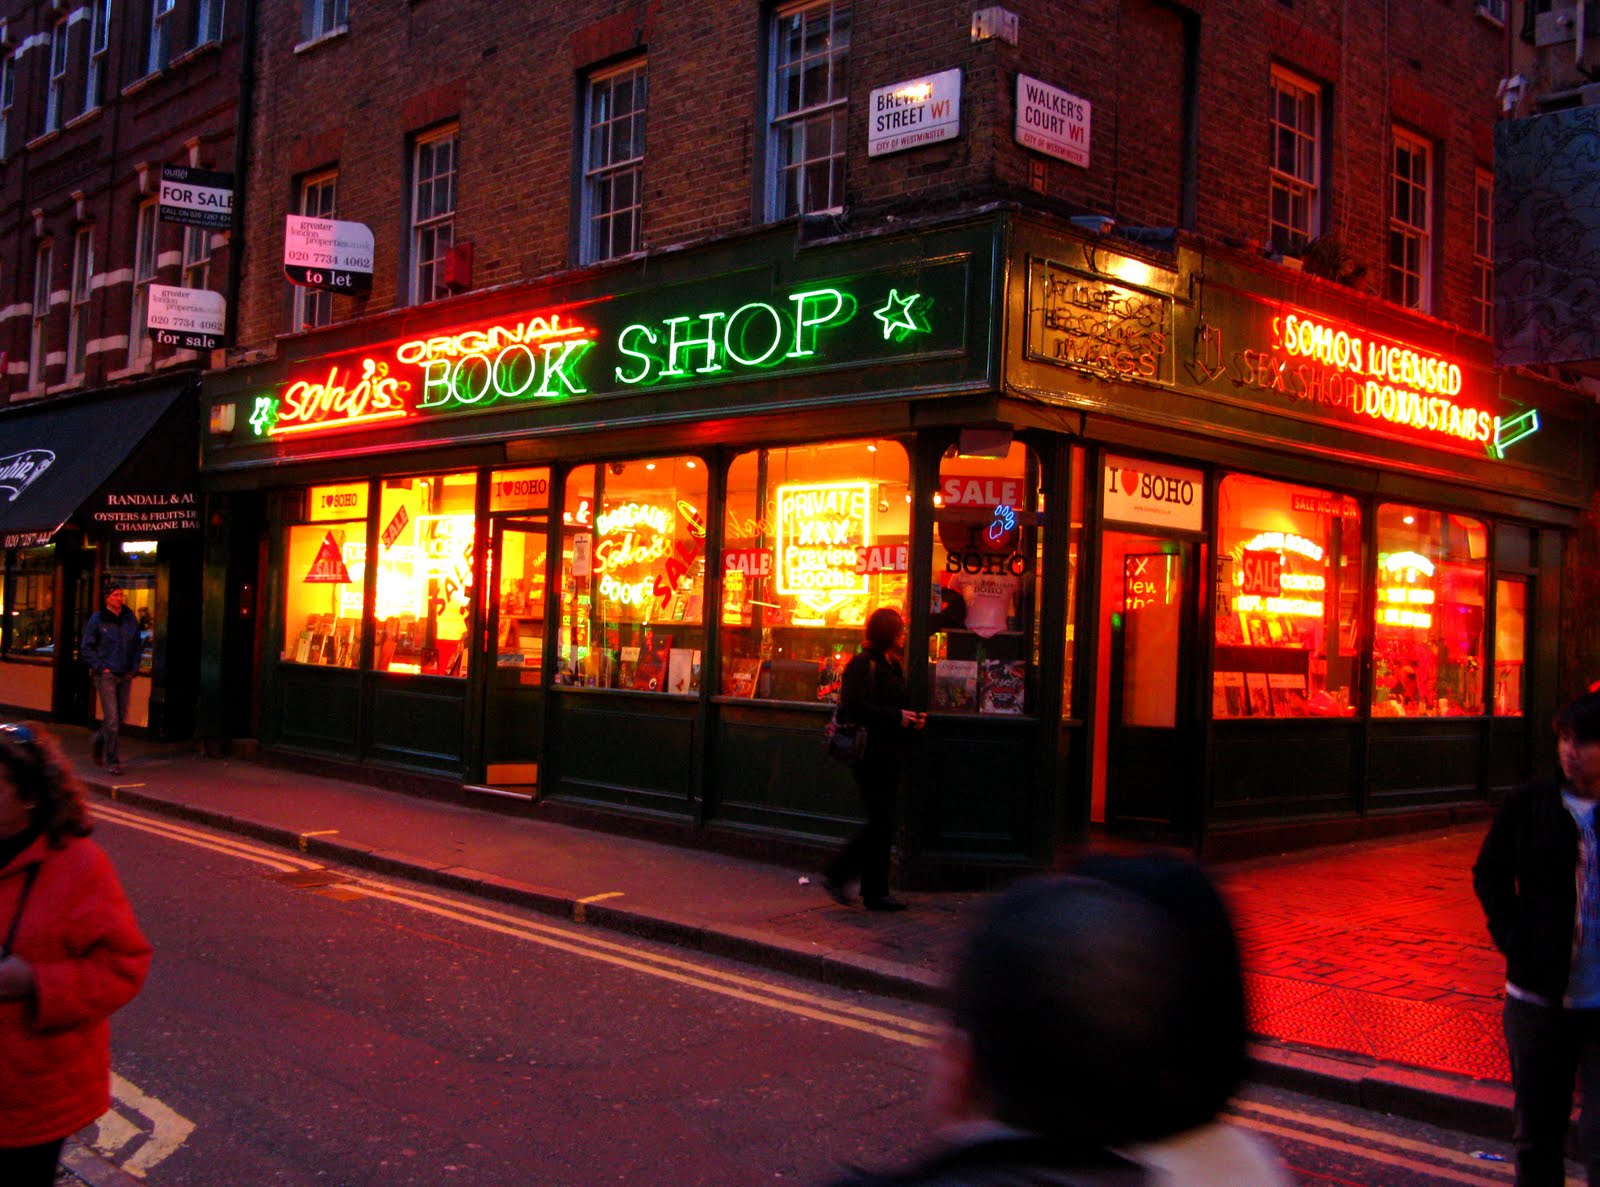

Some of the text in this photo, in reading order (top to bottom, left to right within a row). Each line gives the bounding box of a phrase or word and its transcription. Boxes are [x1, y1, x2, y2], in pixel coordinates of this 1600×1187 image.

[1026, 84, 1084, 122] WALKER'S
[876, 100, 950, 132] STREET W1
[1025, 105, 1085, 144] COURT W1
[876, 128, 945, 152] CITY OF WESTMINSTER
[1024, 132, 1084, 162] CITY OF WESTMINSTER
[163, 187, 233, 208] FOR SALE
[161, 207, 178, 216] CALL
[179, 209, 189, 217] ON
[190, 210, 202, 218] 020
[291, 227, 319, 238] london
[300, 221, 333, 231] greater
[289, 250, 370, 268] 020 7734 4062
[306, 269, 352, 287] to let
[153, 295, 178, 305] london
[161, 290, 191, 299] greater
[151, 315, 223, 331] 020 7734 4062
[157, 330, 216, 349] for sale
[397, 315, 585, 364] ORIGINAL
[416, 289, 843, 409] BOOK SHOP
[1283, 315, 1462, 397] SOHOS LICENSED
[279, 358, 398, 422] Soho's
[1243, 349, 1357, 408] SEX SHOP
[1364, 381, 1491, 442] DOWNSTAIRS
[496, 479, 547, 497] I SOHO
[943, 478, 1017, 506] SALE
[1108, 467, 1194, 506] I SOHO
[108, 494, 168, 506] RANDALL
[170, 493, 179, 504] &
[321, 493, 358, 508] I SOHO
[783, 491, 866, 522] PRIVATE
[1294, 496, 1315, 511] SALE
[1317, 500, 1339, 515] NOW
[94, 511, 139, 522] OYSTERS
[140, 512, 148, 521] &
[149, 510, 186, 521] FRUITS
[115, 520, 179, 533] CHAMPAGNE
[382, 507, 408, 549] SALE
[798, 519, 850, 545] XXX
[315, 559, 343, 580] SALE
[725, 553, 769, 576] SALE
[855, 546, 908, 573] SALE
[945, 551, 1027, 577] SOHO
[789, 567, 855, 588] Booths
[1244, 558, 1280, 596] SALE
